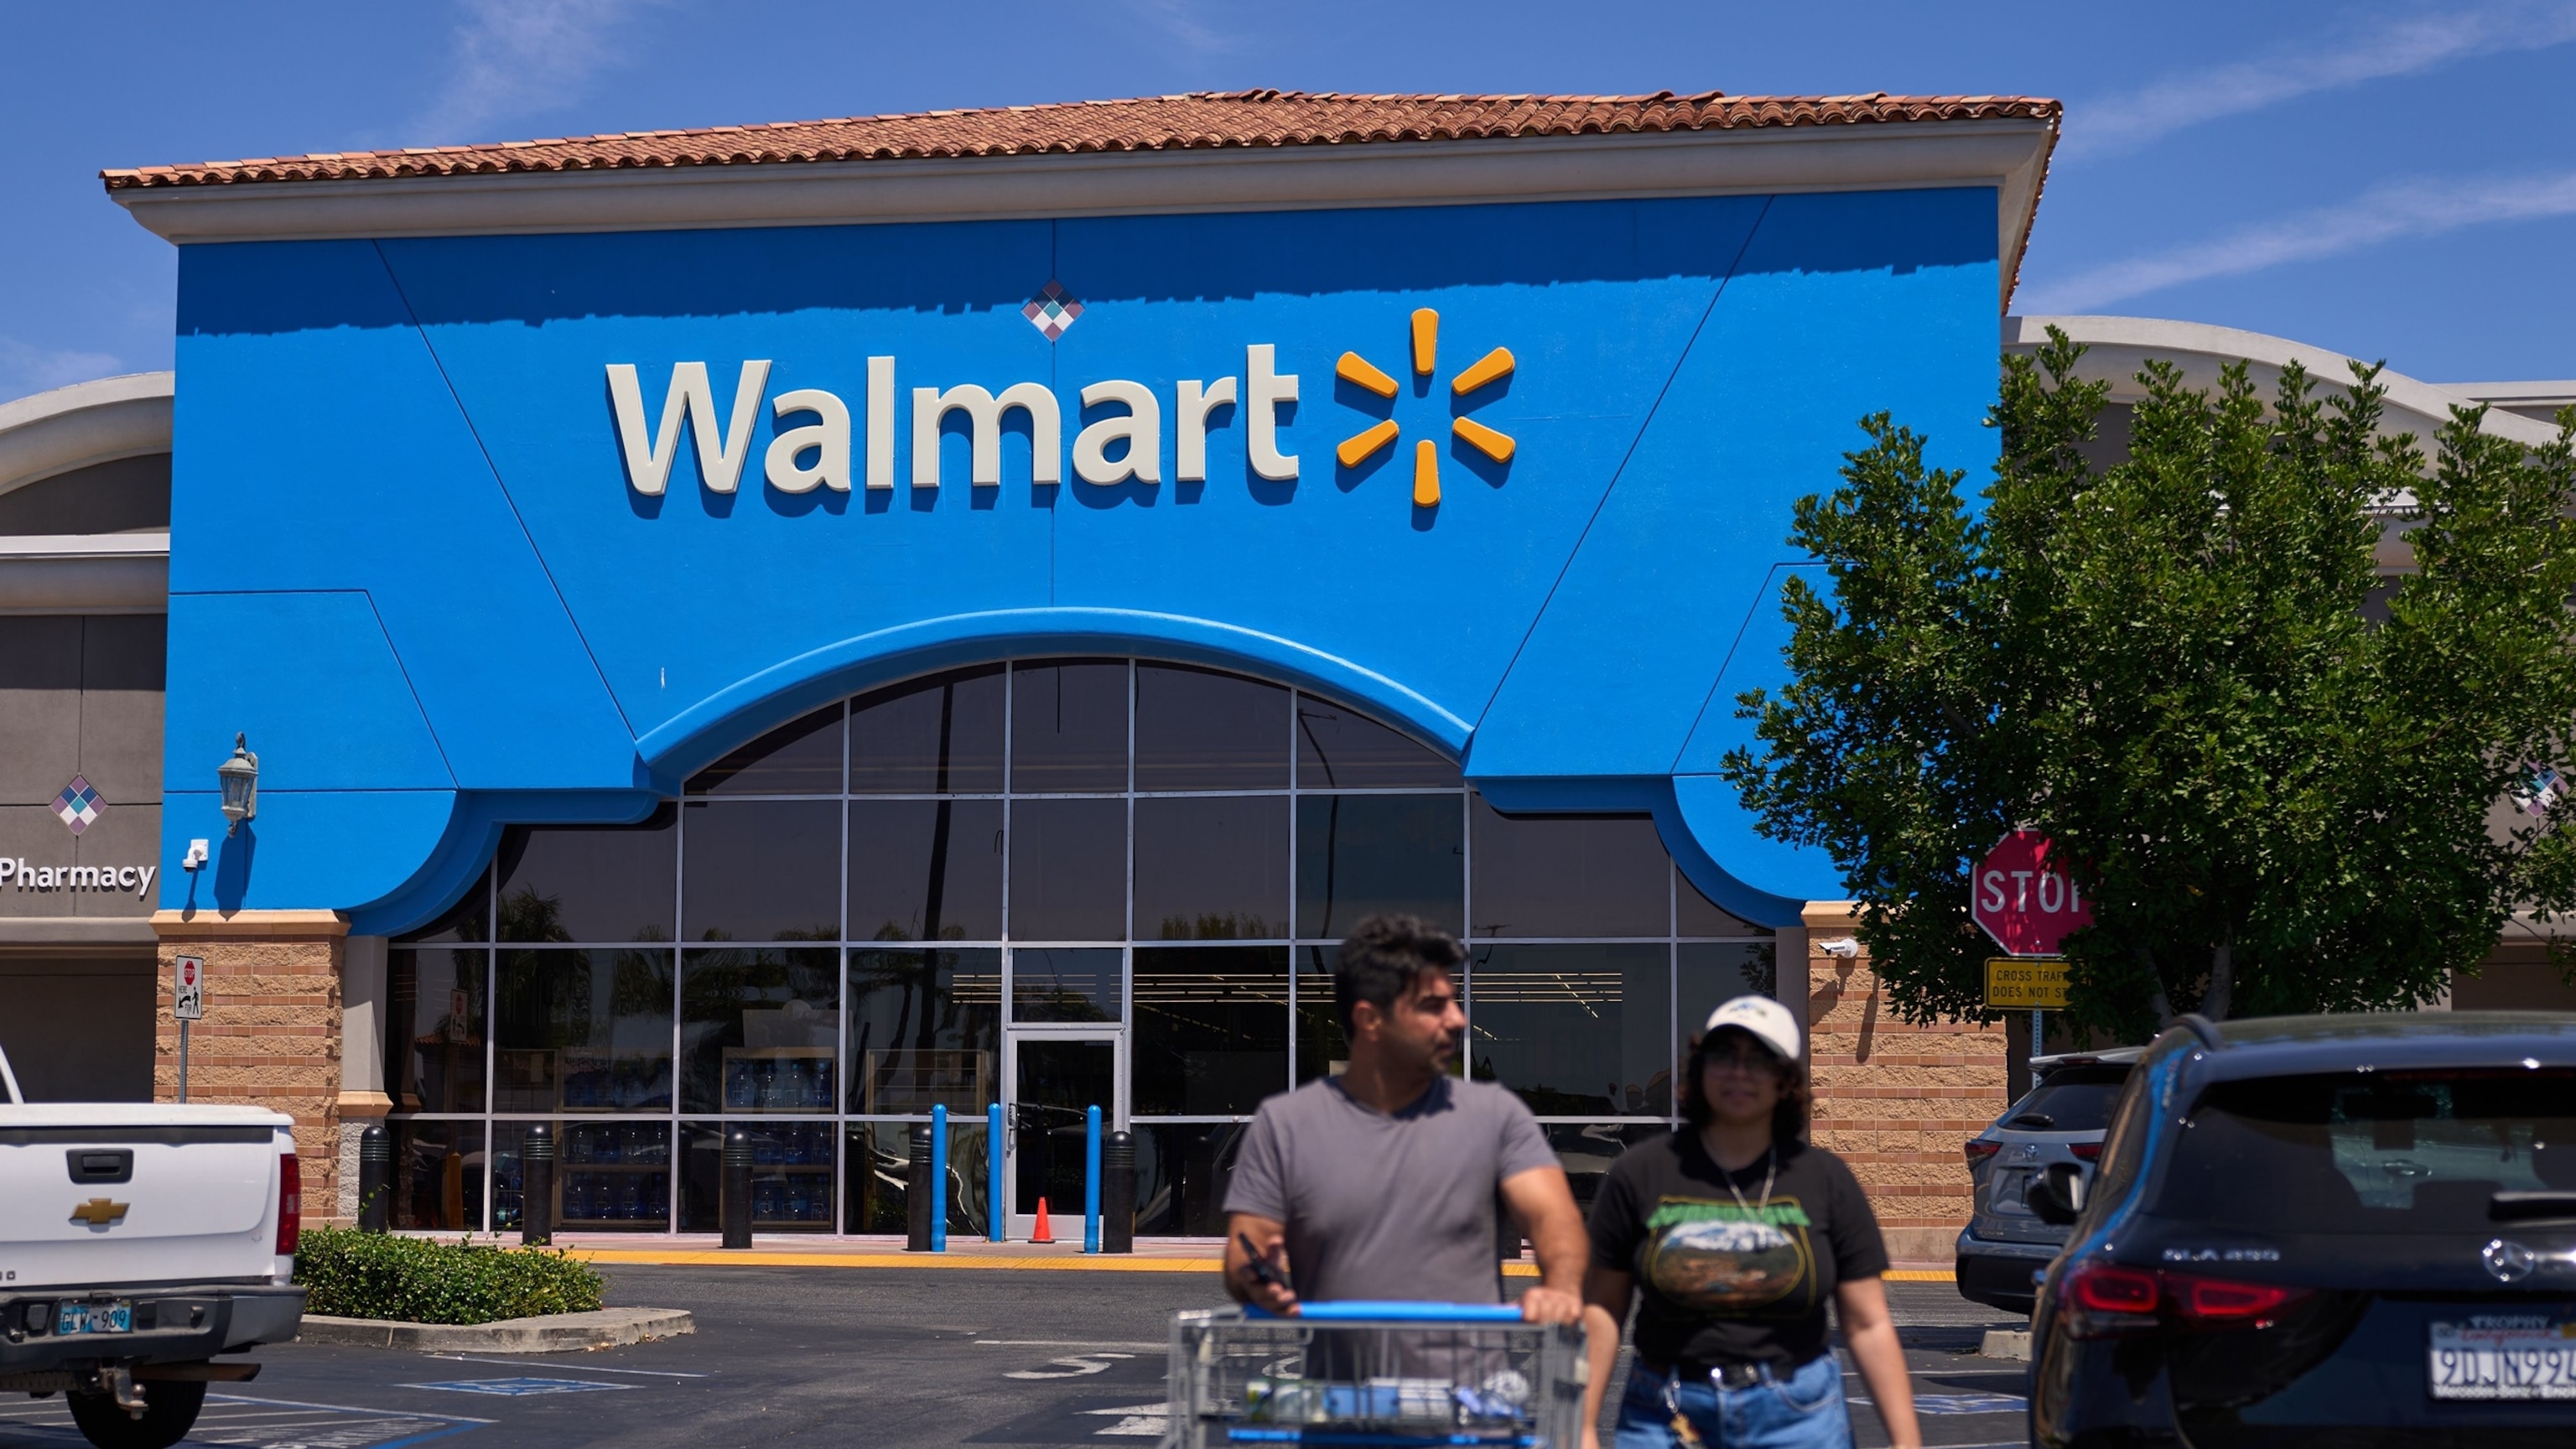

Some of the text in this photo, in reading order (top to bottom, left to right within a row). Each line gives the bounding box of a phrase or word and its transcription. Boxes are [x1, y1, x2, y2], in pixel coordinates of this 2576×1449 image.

[605, 344, 1298, 496] Walmart
[0, 858, 157, 896] Pharmacy
[1996, 970, 2066, 982] CROSS TRAF
[1992, 986, 2067, 998] DOES NOT ST
[2469, 1315, 2550, 1330] TROPHY
